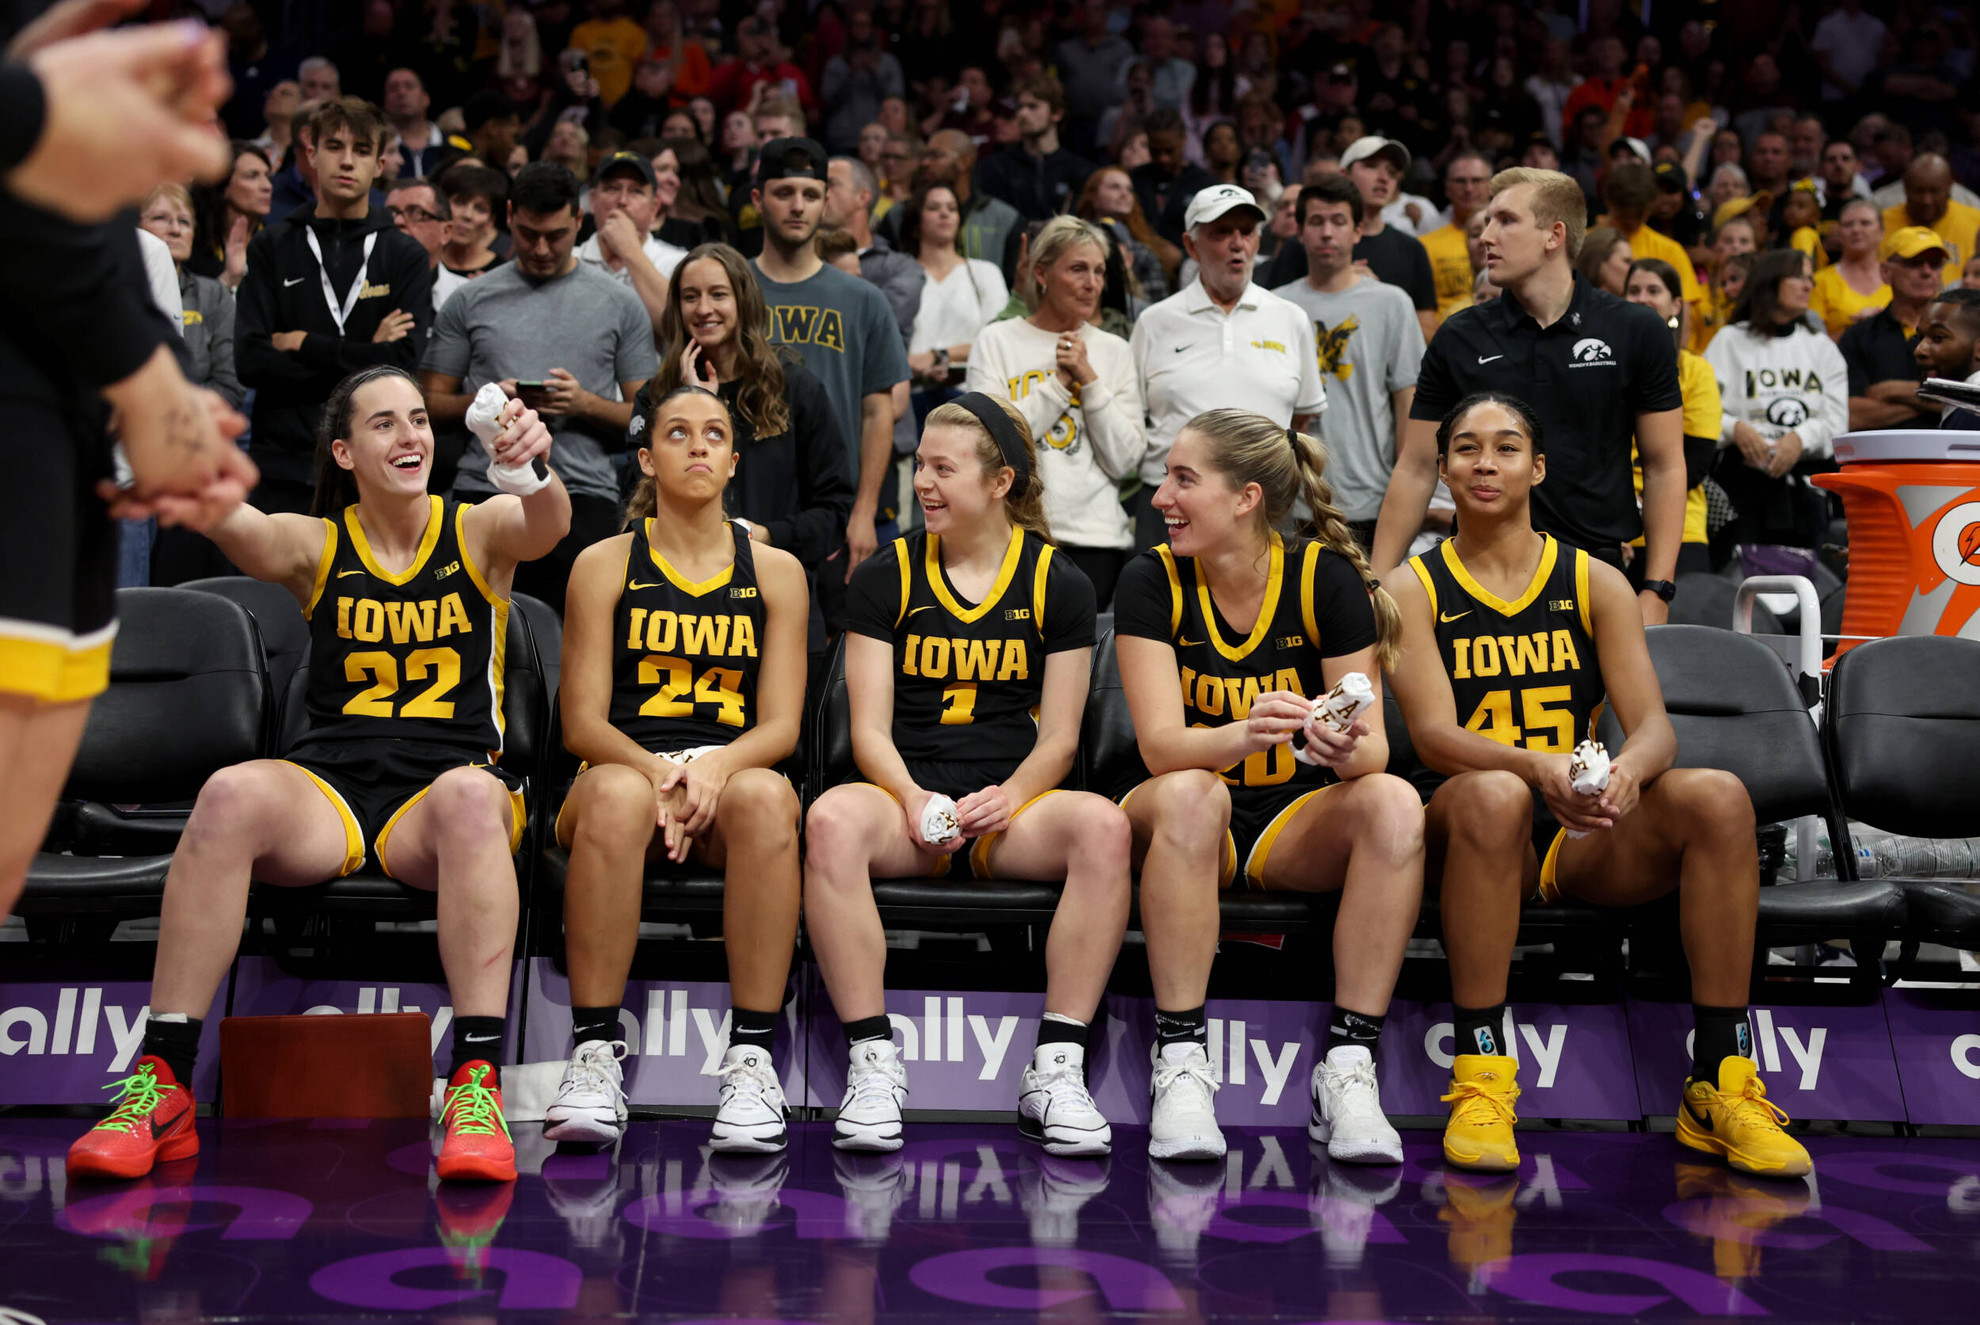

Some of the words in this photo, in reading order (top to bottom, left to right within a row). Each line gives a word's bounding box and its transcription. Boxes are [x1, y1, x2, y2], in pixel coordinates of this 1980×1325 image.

[765, 305, 844, 352] WA
[1746, 368, 1824, 399] IOWA
[336, 591, 472, 644] IOWA
[627, 608, 758, 657] IOWA
[902, 634, 1029, 680] IOWA
[1453, 629, 1581, 679] IOWA
[342, 646, 461, 719] 22
[638, 654, 746, 728] 24
[940, 681, 978, 725] 1
[1181, 665, 1305, 720] IOWA
[1465, 684, 1575, 754] 45
[0, 987, 151, 1073] ally
[1208, 1018, 1301, 1105] lly
